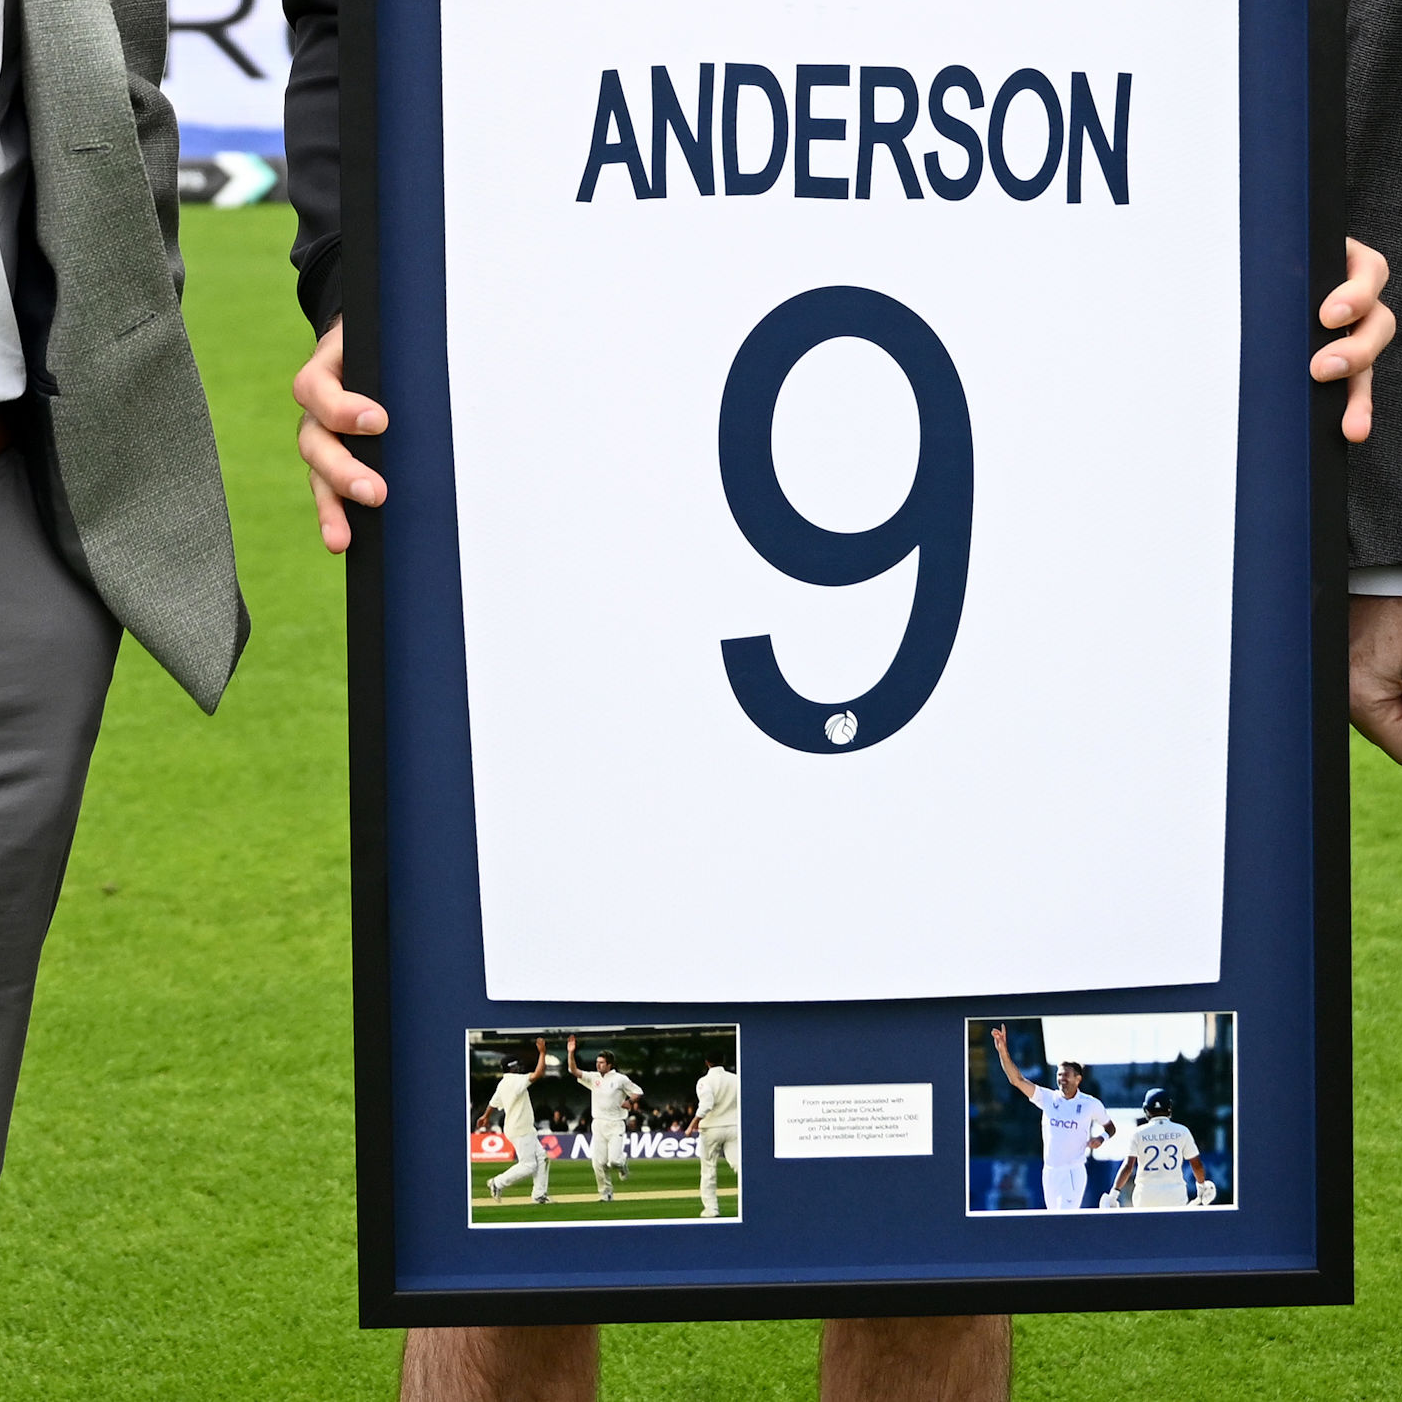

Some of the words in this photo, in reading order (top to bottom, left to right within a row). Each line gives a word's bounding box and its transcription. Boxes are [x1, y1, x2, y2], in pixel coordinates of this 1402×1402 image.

[575, 62, 1133, 205] ANDERSON
[718, 285, 975, 755] 9
[1141, 1132, 1182, 1142] KULDEEP
[1143, 1144, 1179, 1171] 23
